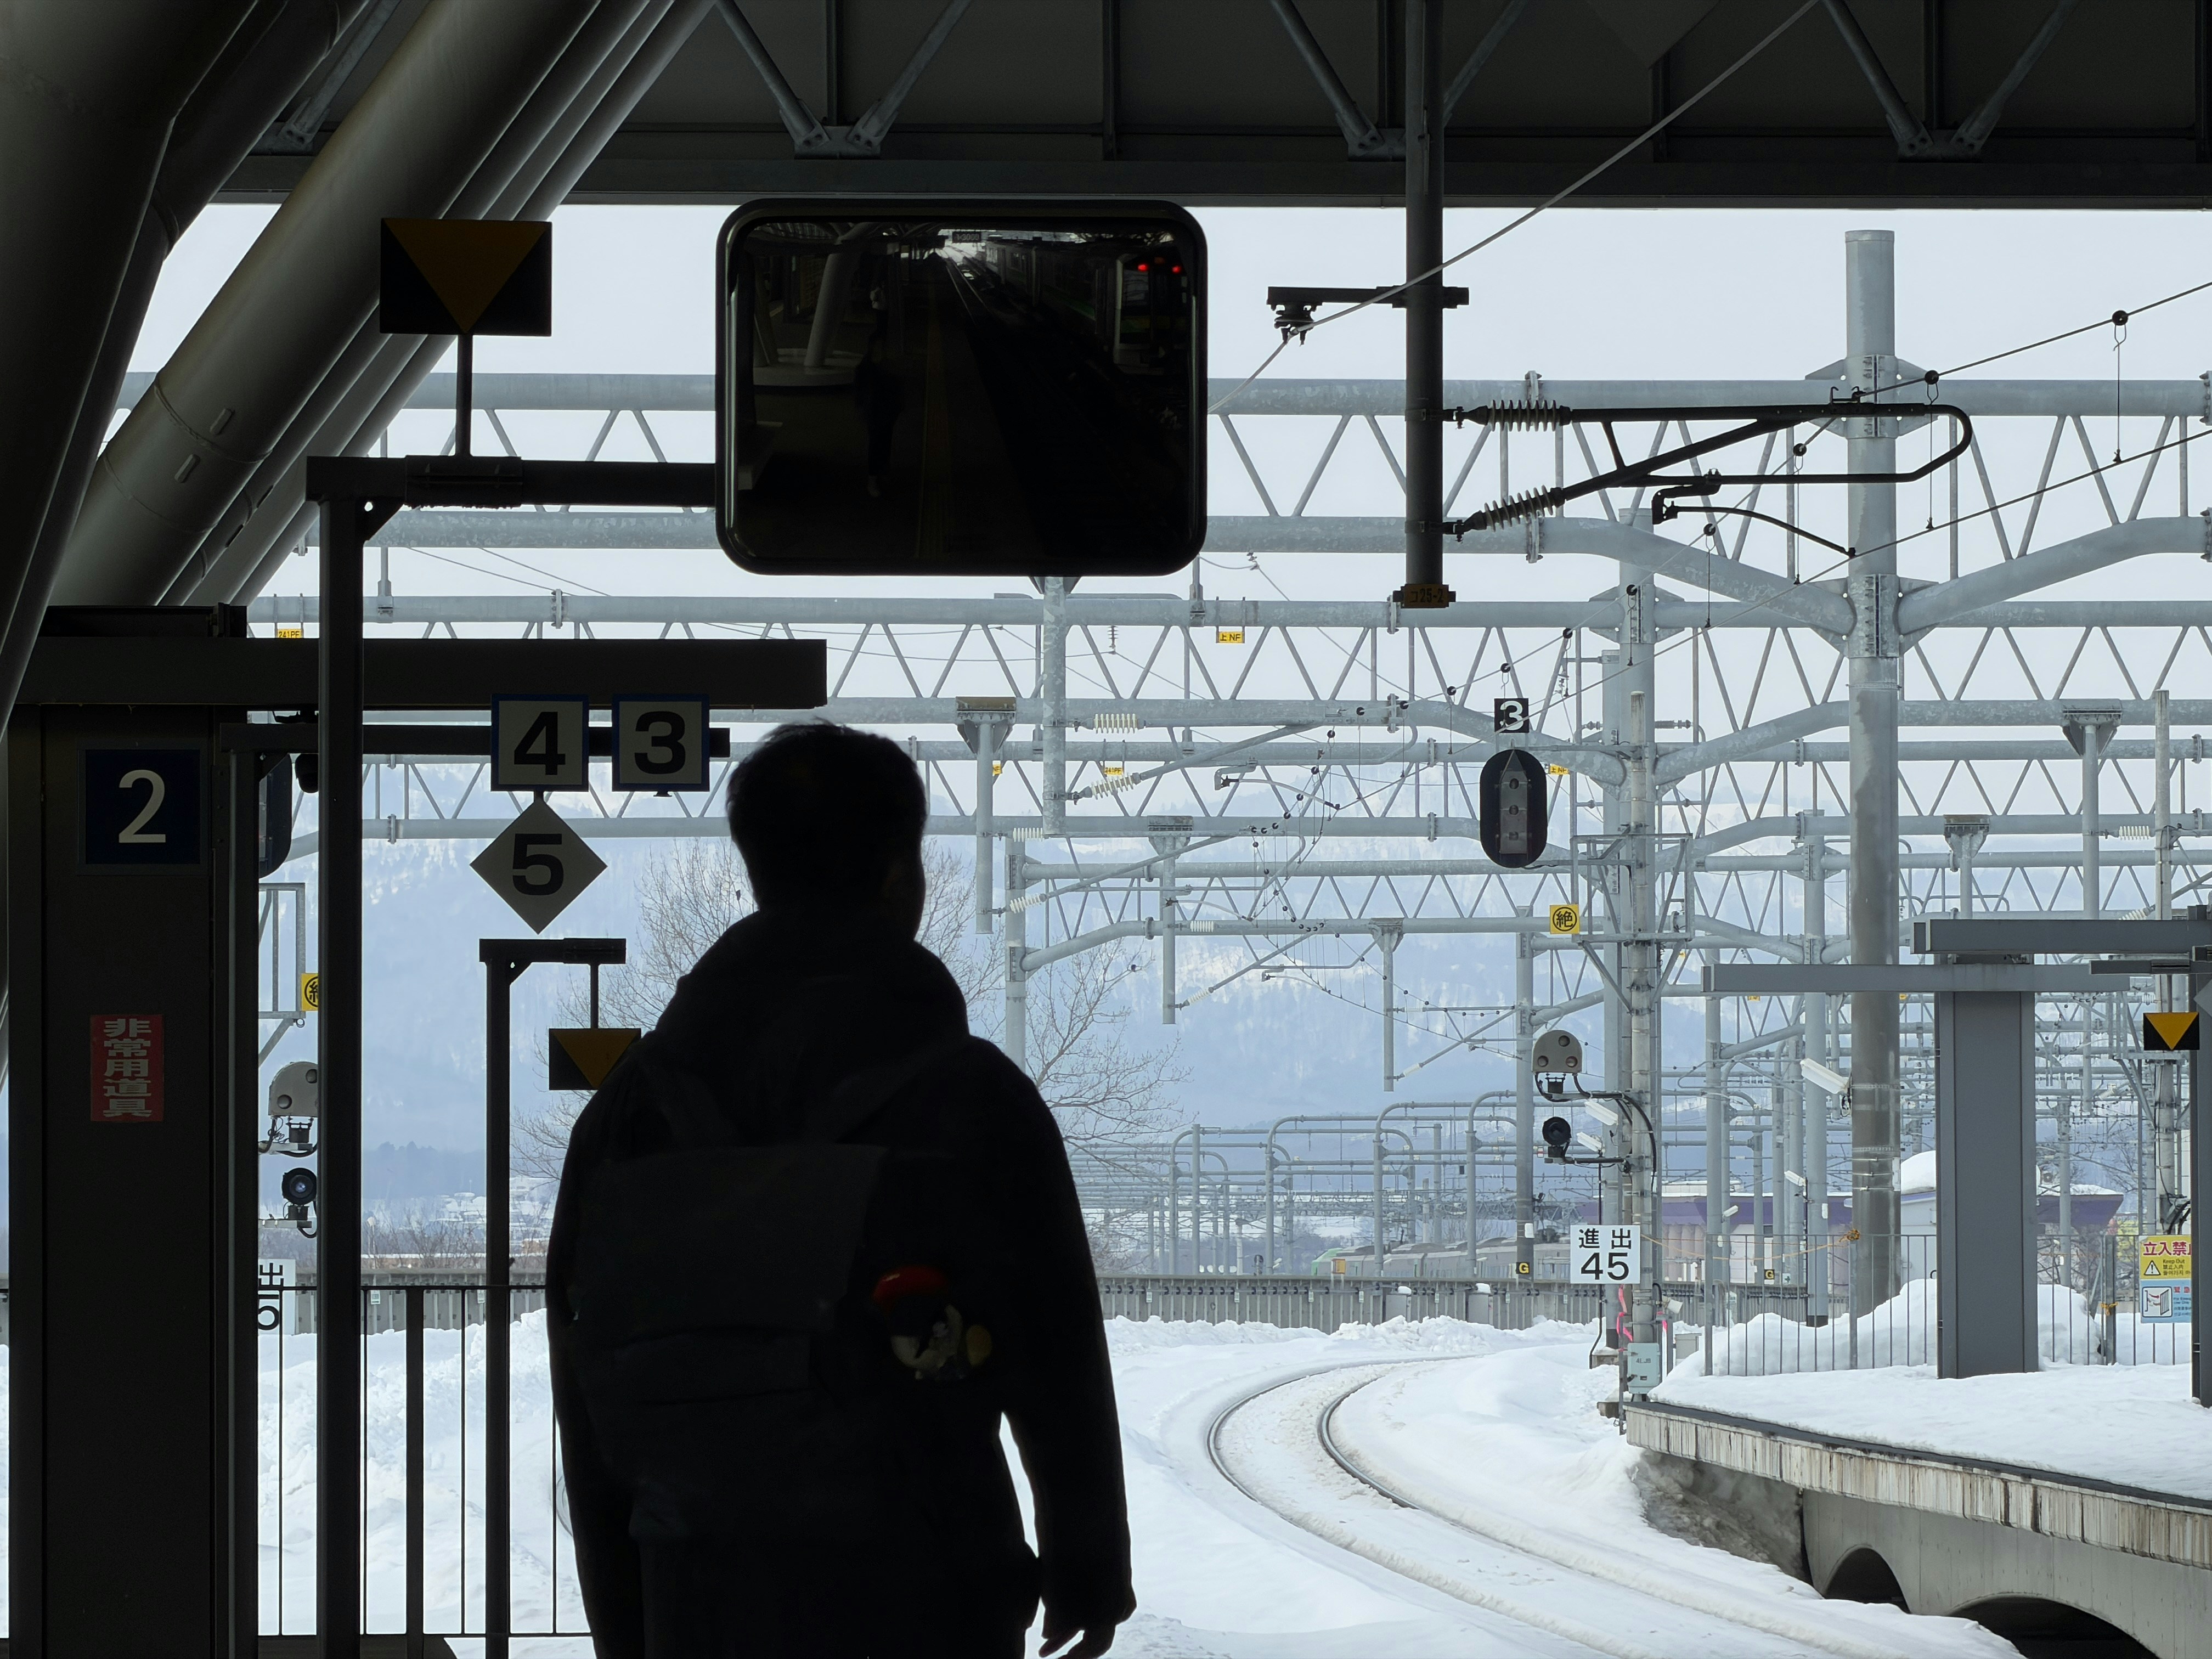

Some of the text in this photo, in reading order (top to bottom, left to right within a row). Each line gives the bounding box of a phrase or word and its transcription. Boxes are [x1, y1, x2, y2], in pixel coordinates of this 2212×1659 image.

[514, 712, 566, 775] 4
[634, 711, 686, 774] 3
[1500, 701, 1523, 730] 3
[119, 769, 166, 843] 2
[512, 833, 565, 896] 5
[1556, 910, 1573, 928] 絶
[103, 1018, 152, 1118] 非常用道具
[1519, 1262, 1529, 1273] G
[1581, 1252, 1629, 1280] 45
